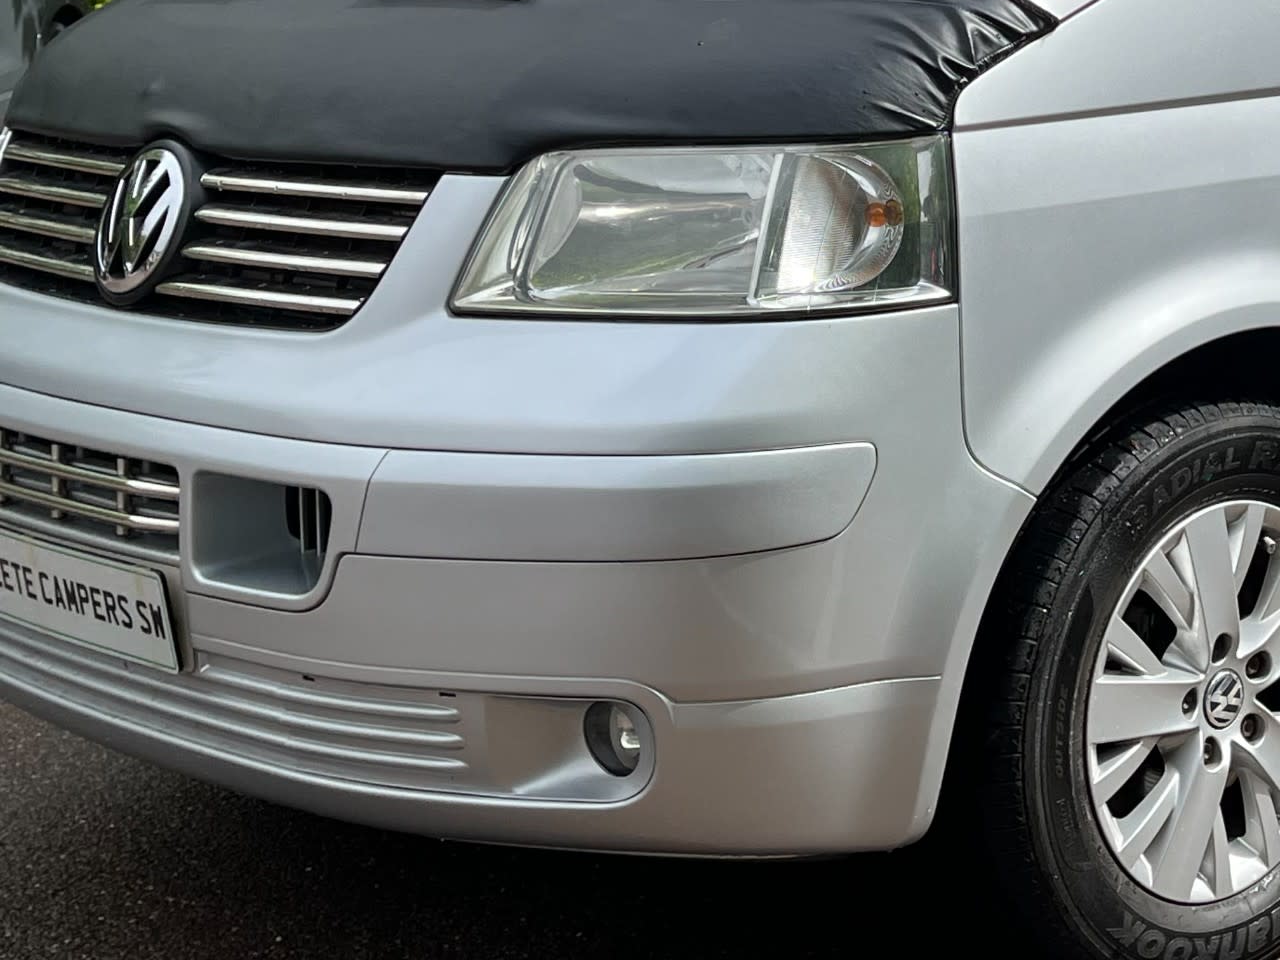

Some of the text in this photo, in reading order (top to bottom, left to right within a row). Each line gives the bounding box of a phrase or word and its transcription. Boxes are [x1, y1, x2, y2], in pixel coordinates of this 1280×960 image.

[0, 558, 166, 639] ETE CAMPERS SW
